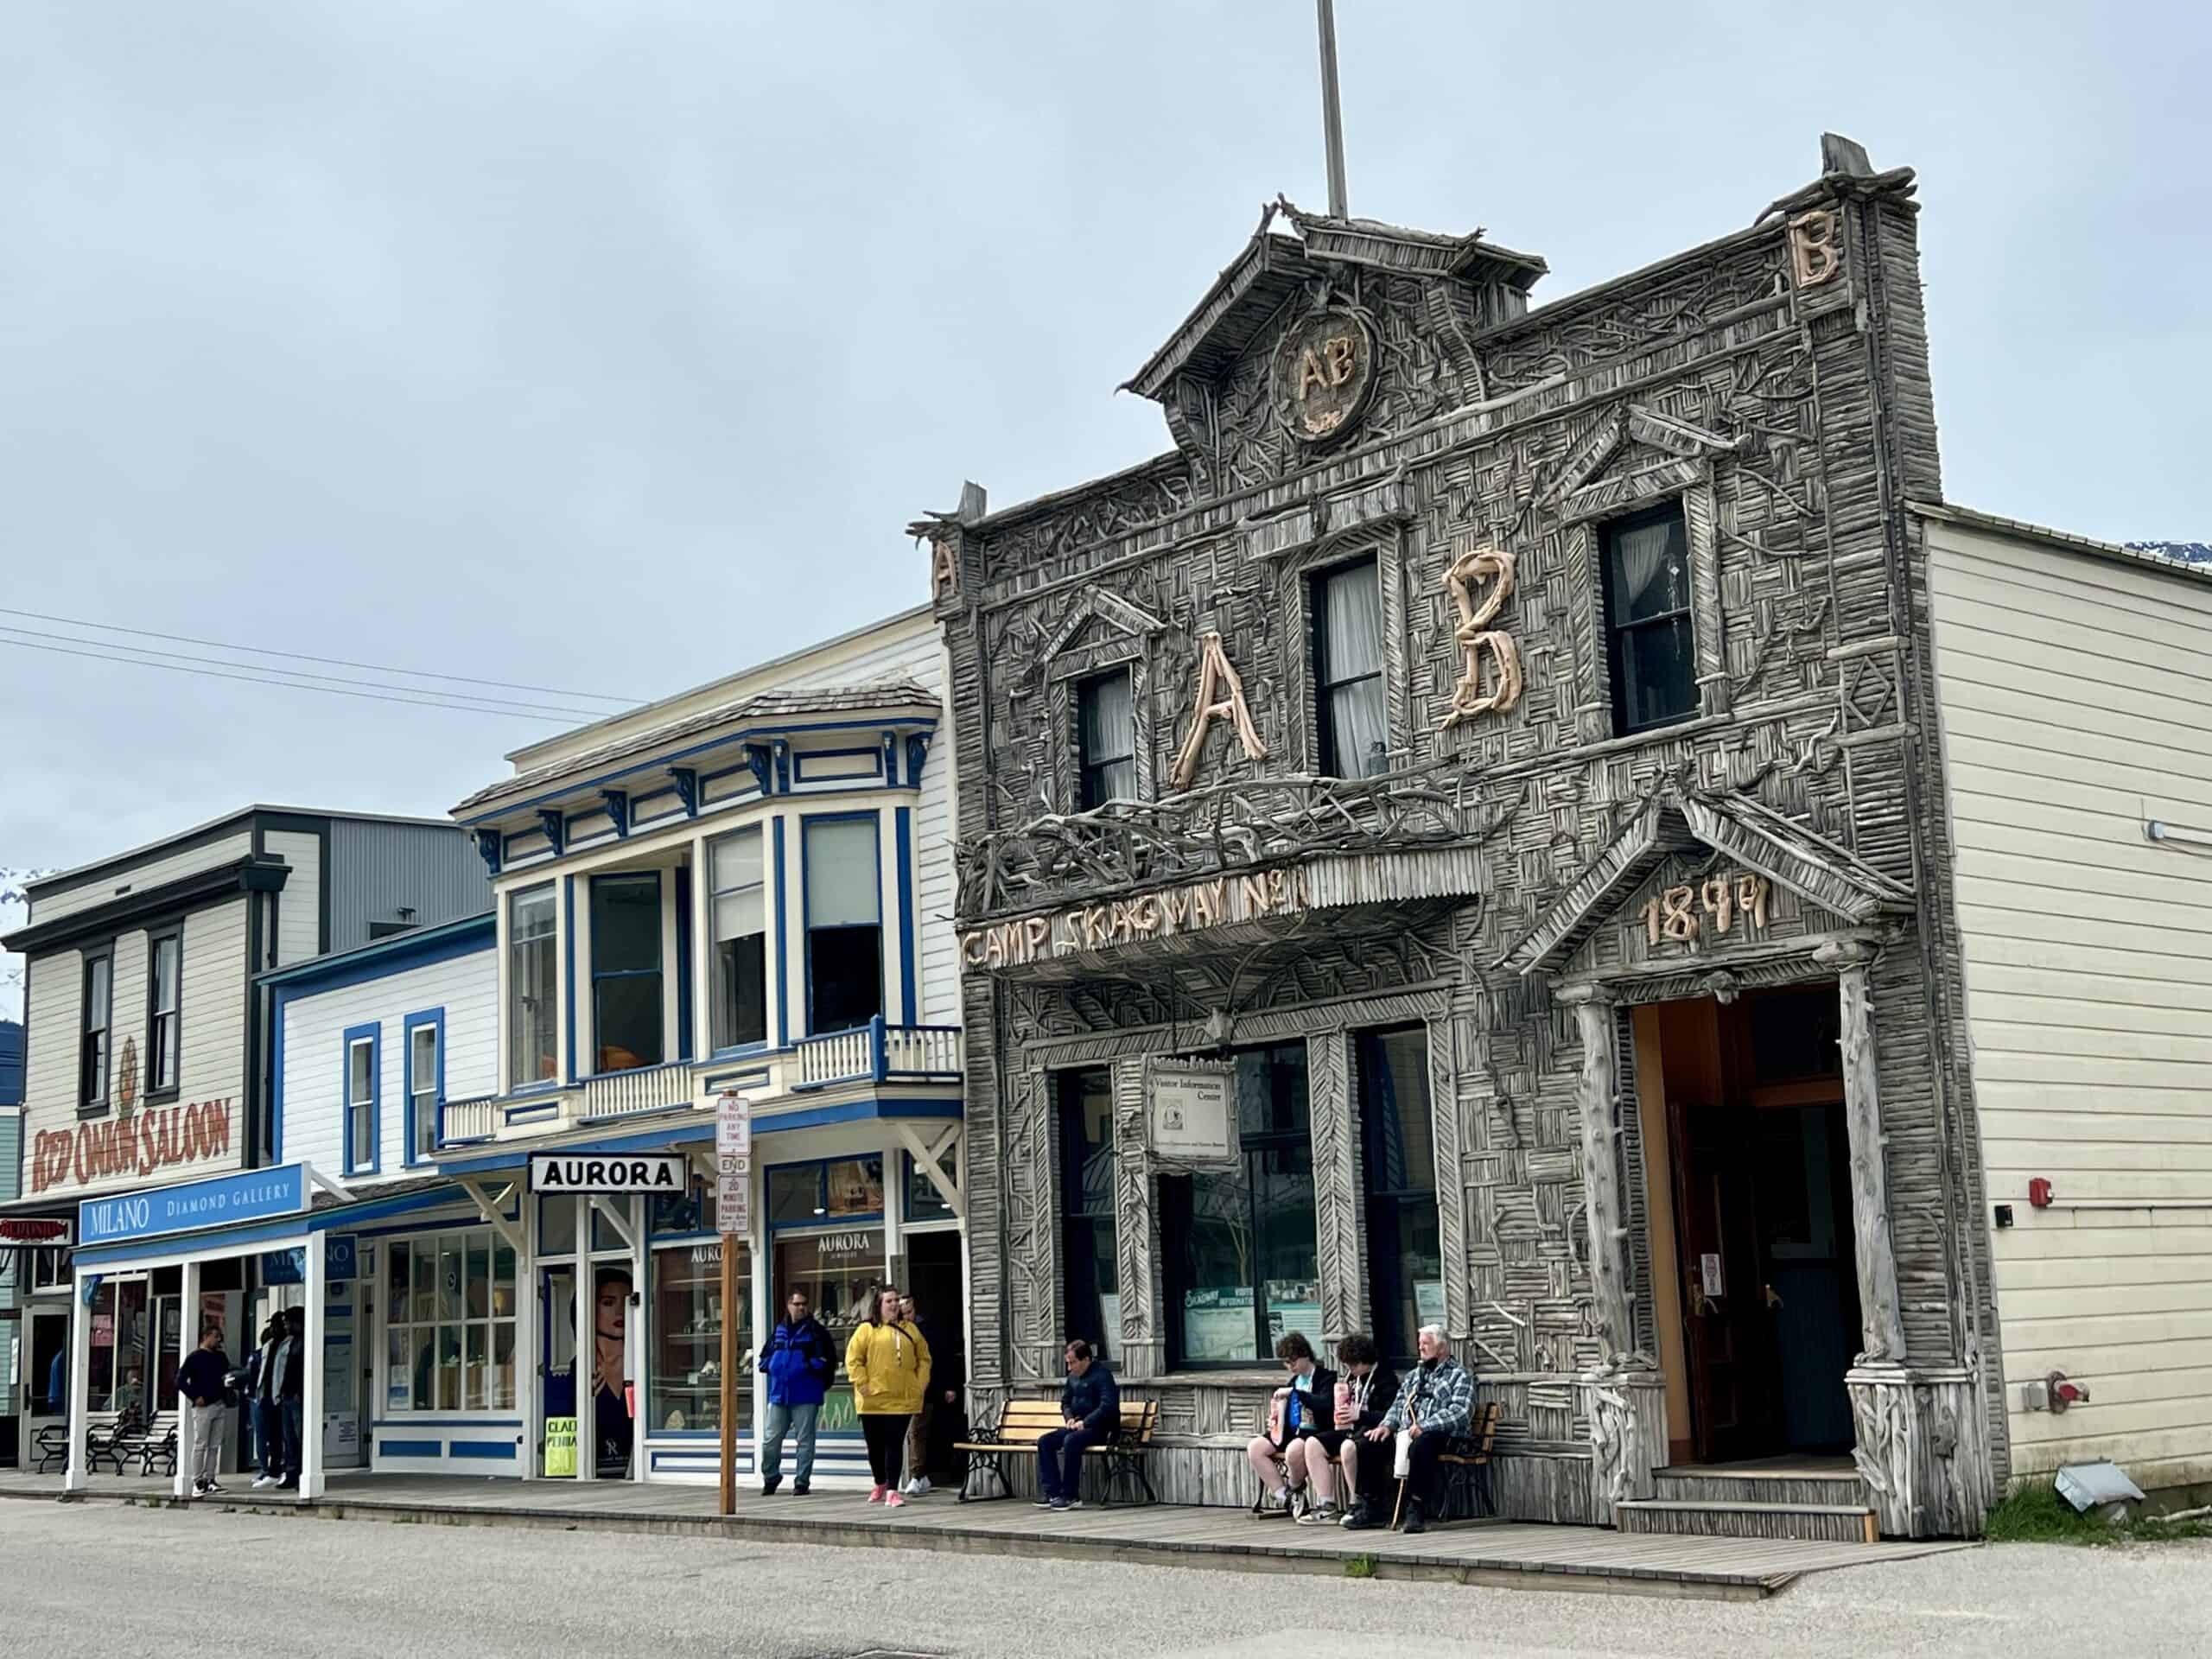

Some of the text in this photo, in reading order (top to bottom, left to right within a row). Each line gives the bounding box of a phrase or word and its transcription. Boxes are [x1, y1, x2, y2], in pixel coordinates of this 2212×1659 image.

[1788, 210, 1840, 289] B
[962, 917, 1051, 965] CAMP
[1056, 876, 1227, 950] SKAGWAY
[1638, 873, 1770, 946] 1899
[728, 1103, 739, 1112] NO
[31, 1097, 231, 1193] RED ONION SALOON
[542, 1160, 674, 1185] AURORA
[721, 1160, 746, 1171] END
[722, 1193, 744, 1202] MINUTE
[728, 1181, 740, 1192] 20
[89, 1182, 291, 1236] MILANO DIAMOND GALLERY
[721, 1204, 747, 1213] PARKING
[817, 1233, 870, 1253] AURORA
